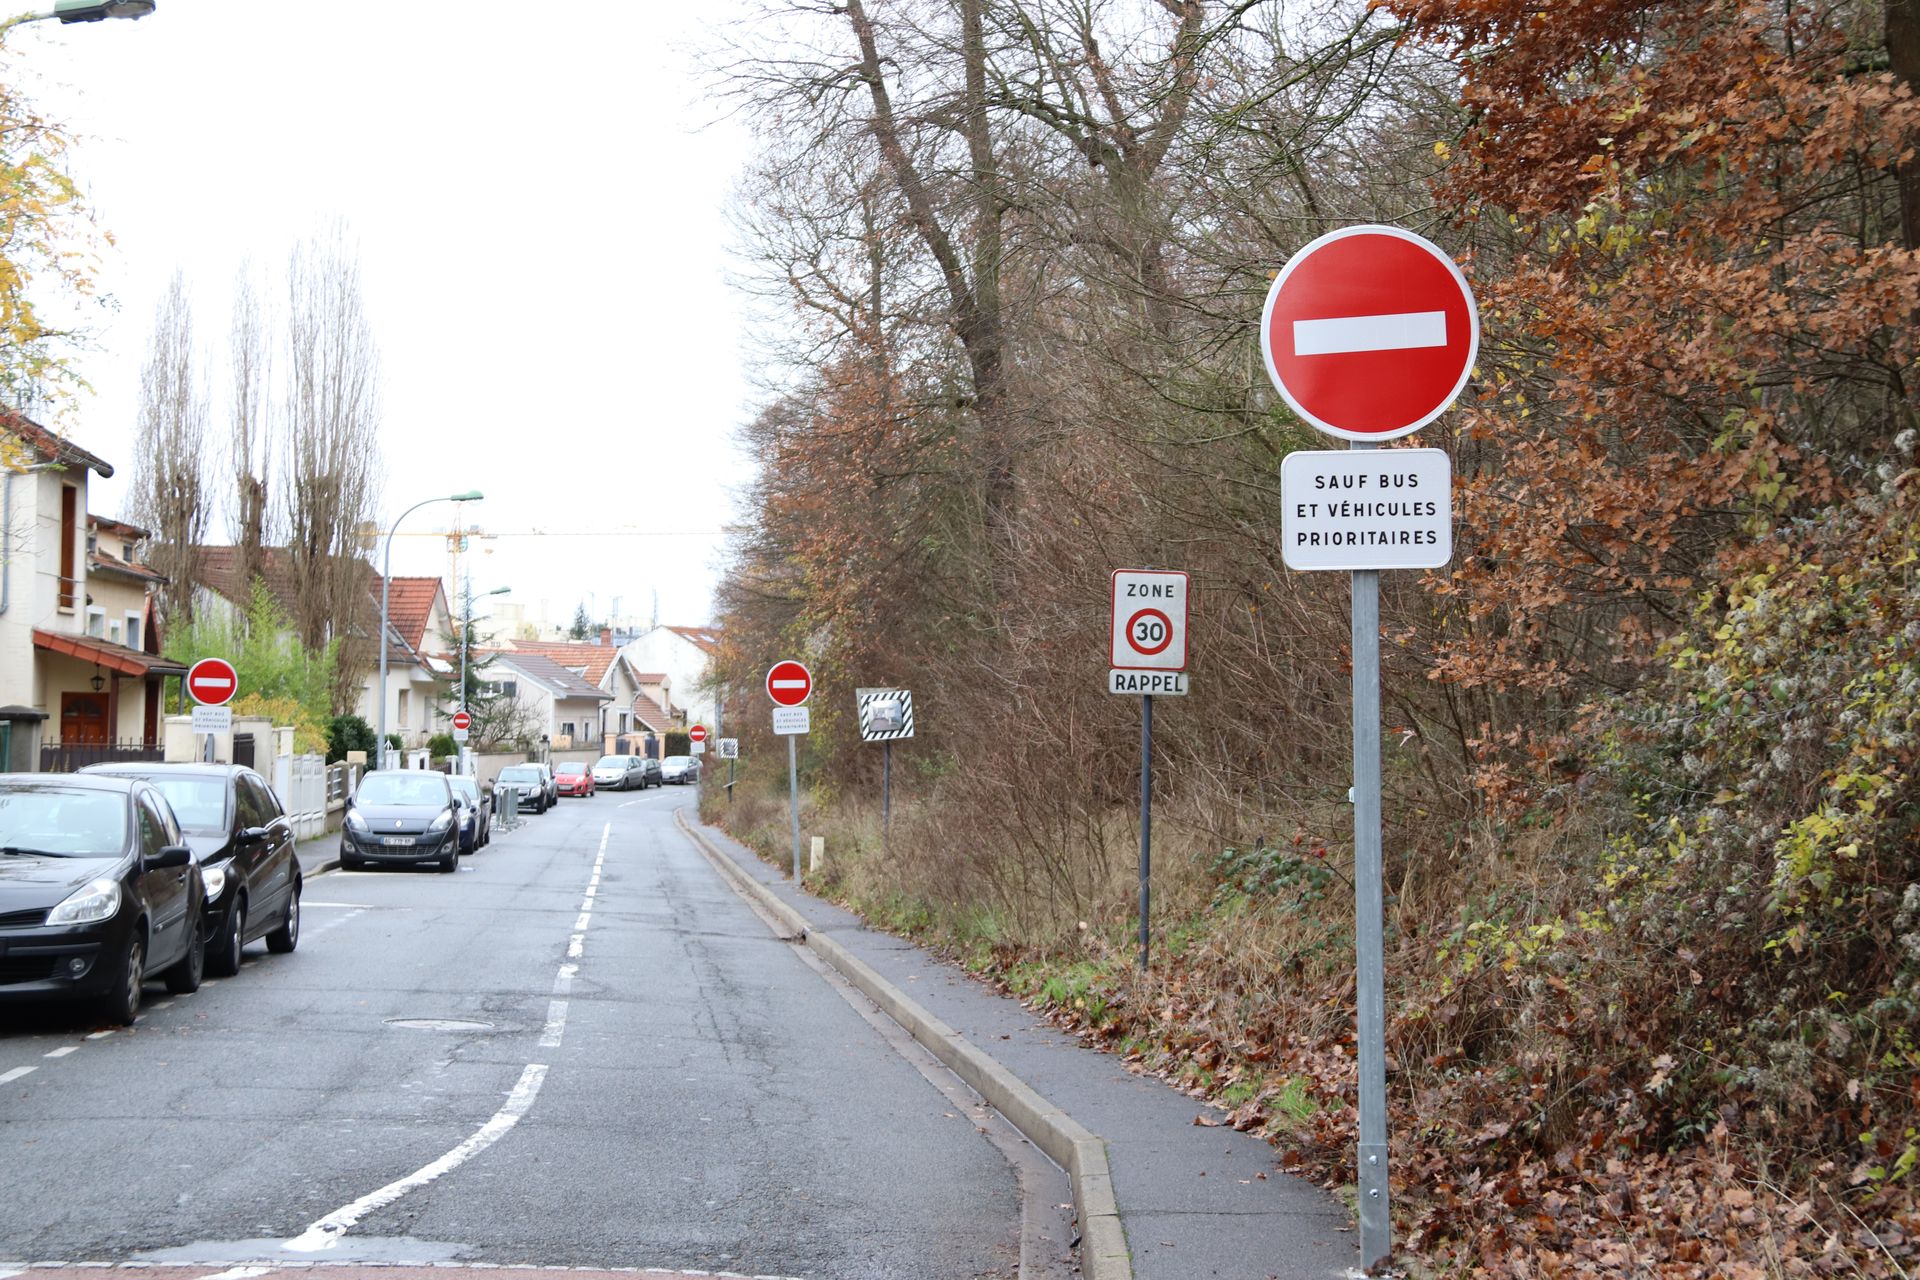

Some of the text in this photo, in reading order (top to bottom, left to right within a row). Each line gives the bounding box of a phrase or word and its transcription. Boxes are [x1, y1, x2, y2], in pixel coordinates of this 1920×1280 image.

[1314, 473, 1419, 489] SAUF BUS
[1296, 500, 1437, 518] ET VÉHICULES
[1297, 530, 1437, 546] PRIORITAIRES
[1127, 583, 1175, 598] ZONE
[1135, 622, 1164, 642] 30
[1115, 673, 1183, 692] RAPPEL
